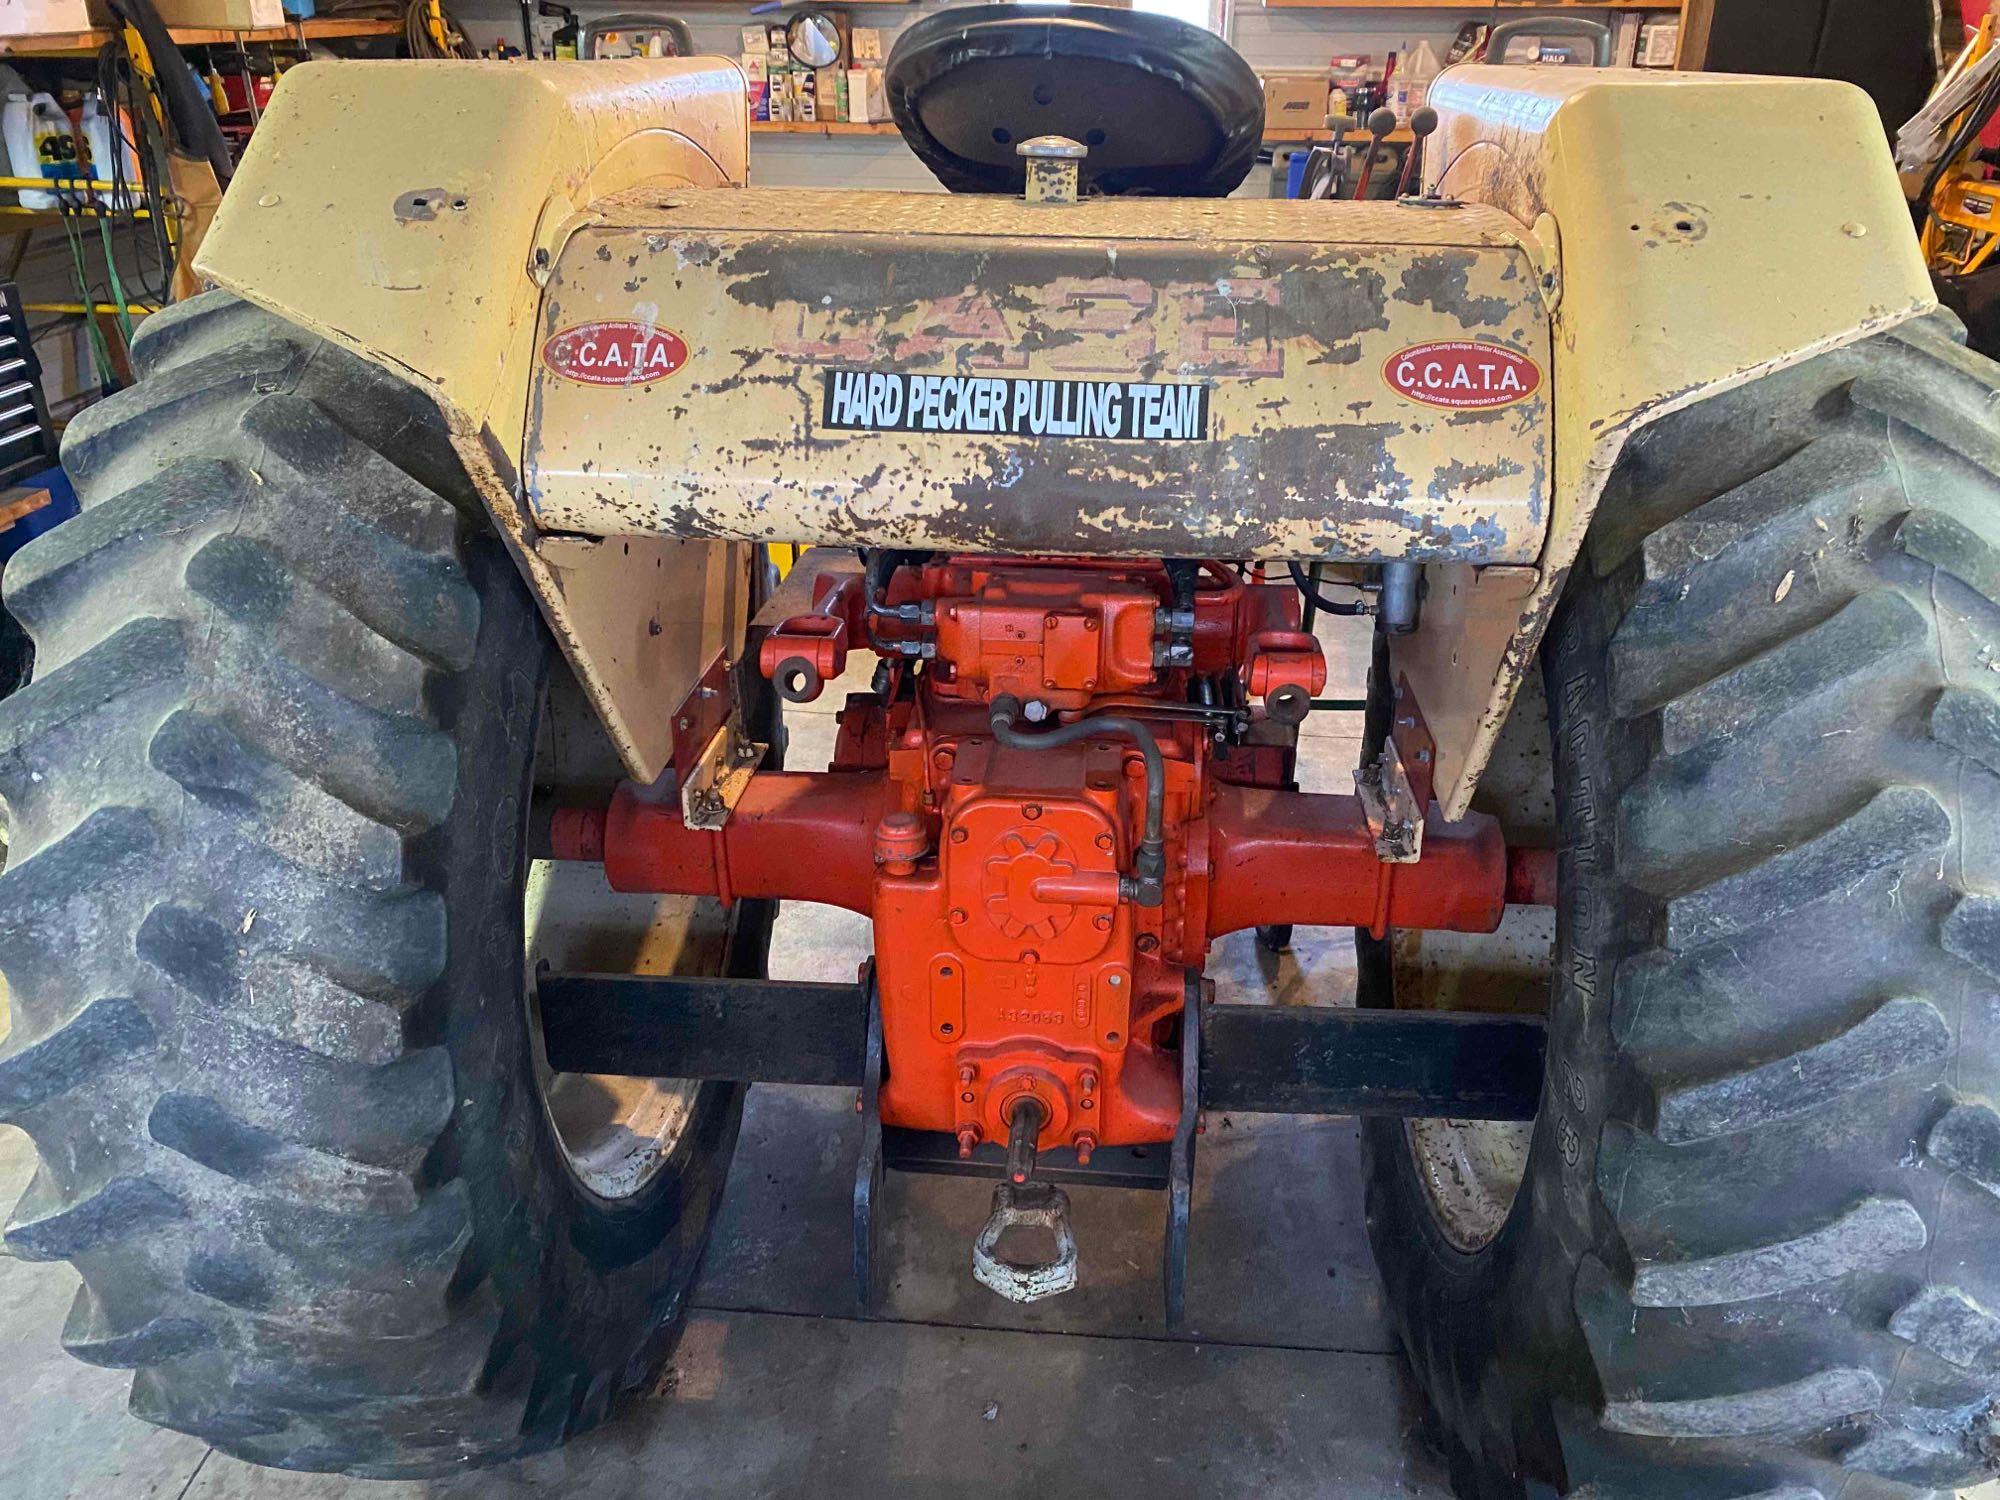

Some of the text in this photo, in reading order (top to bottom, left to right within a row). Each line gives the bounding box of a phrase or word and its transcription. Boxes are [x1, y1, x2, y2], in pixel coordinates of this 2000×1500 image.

[1542, 54, 1565, 63] HALO
[554, 341, 675, 368] C.C.A.T.A.
[1400, 342, 1524, 365] Columbiana County Antique Tractor Association
[1396, 361, 1527, 391] C.C.A.T.A.
[830, 371, 1201, 439] HARD PECKER PULLING TEAM
[1411, 389, 1513, 406] http://ccata.squarespace.com
